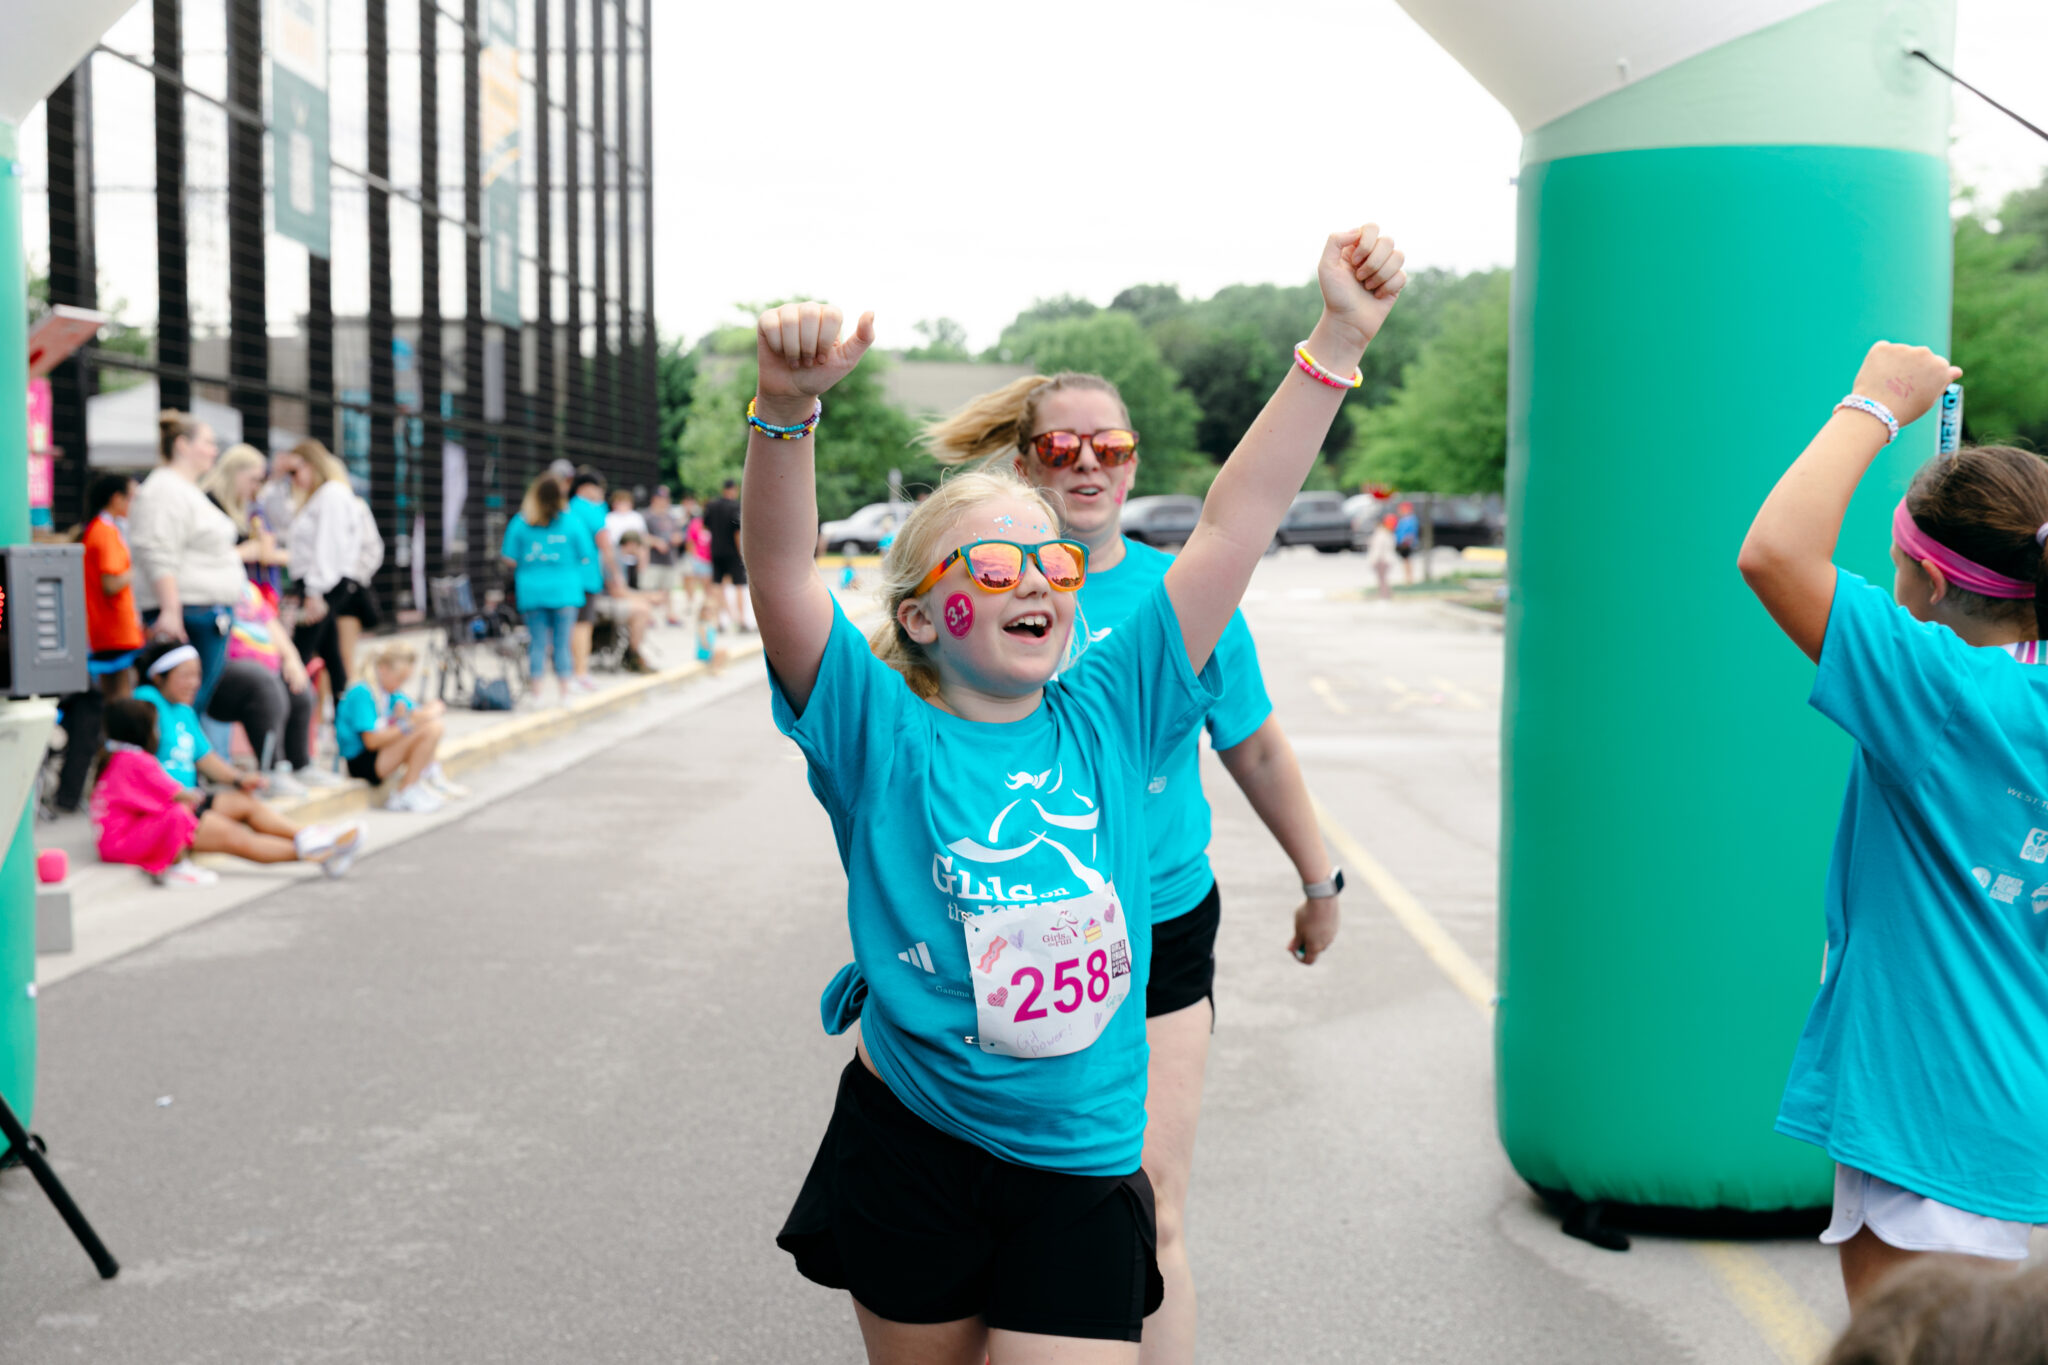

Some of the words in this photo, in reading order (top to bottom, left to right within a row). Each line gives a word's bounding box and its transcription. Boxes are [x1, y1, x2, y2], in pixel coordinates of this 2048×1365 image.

[947, 598, 970, 627] 3.1
[1039, 887, 1070, 899] on
[1042, 932, 1066, 943] Girls
[935, 985, 970, 998] Gamma
[1010, 948, 1110, 1024] 258
